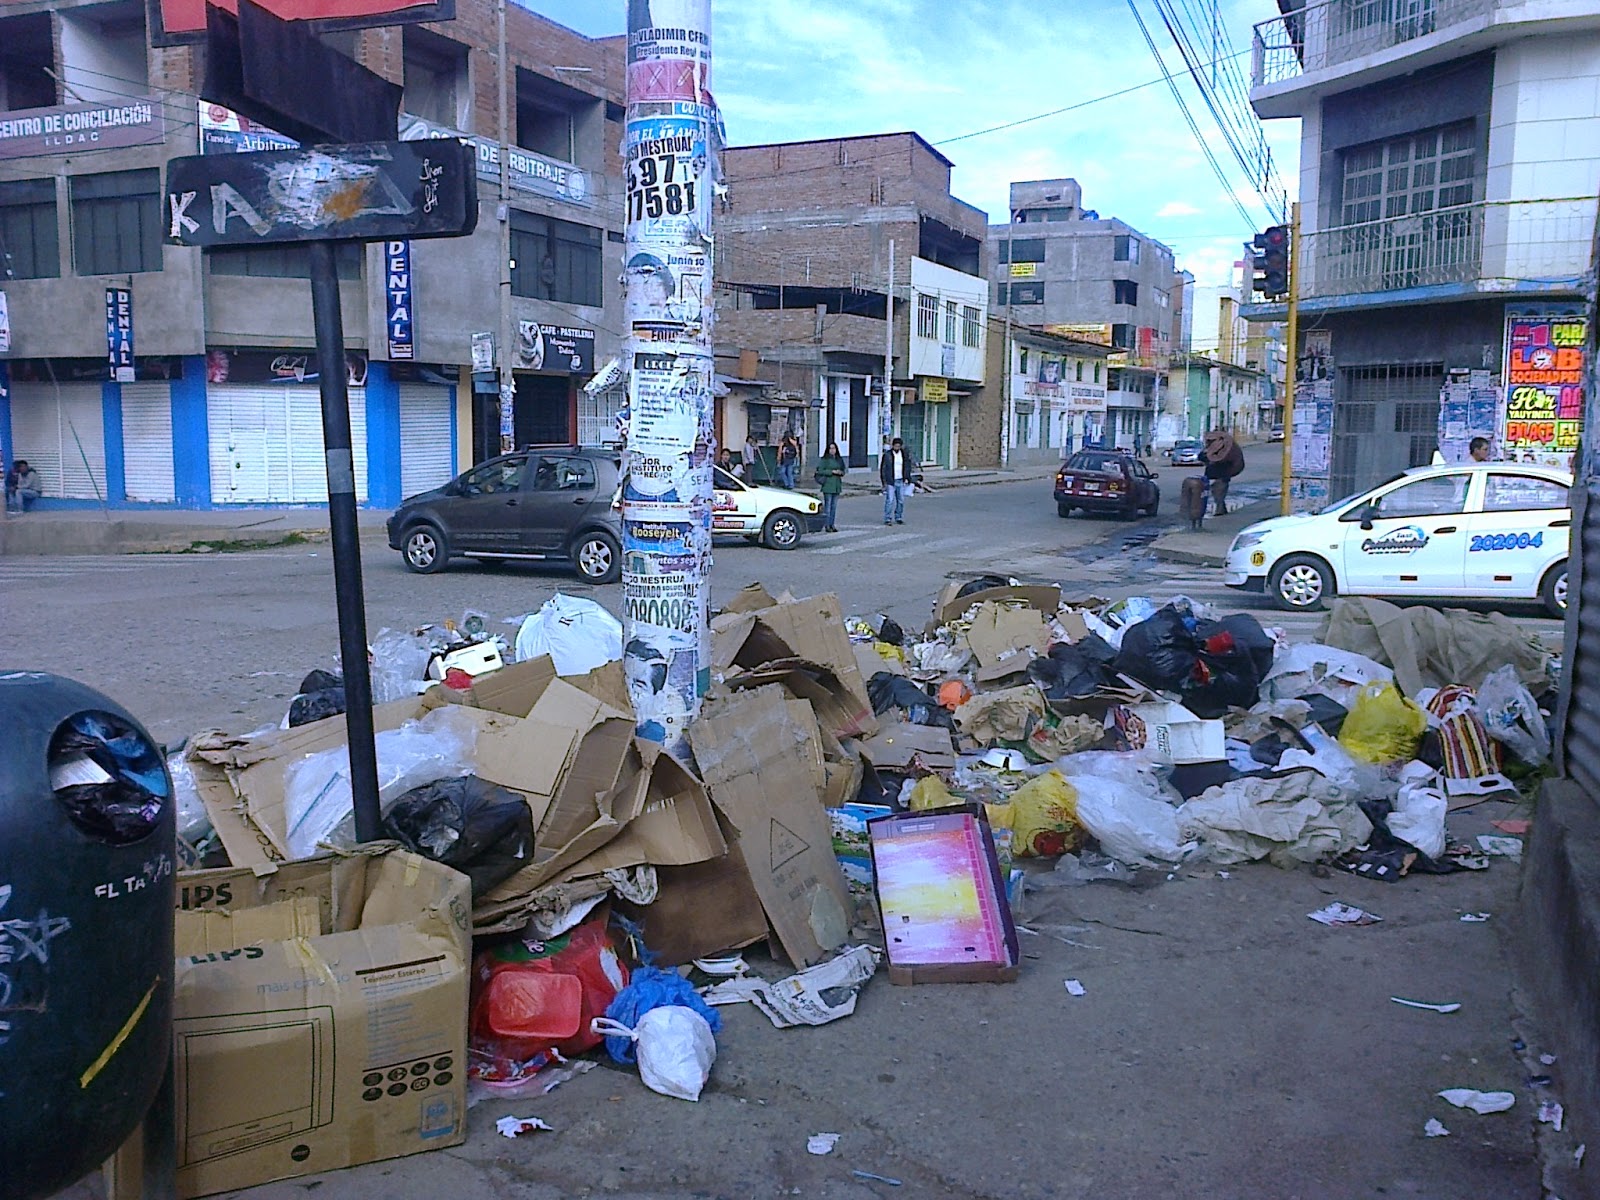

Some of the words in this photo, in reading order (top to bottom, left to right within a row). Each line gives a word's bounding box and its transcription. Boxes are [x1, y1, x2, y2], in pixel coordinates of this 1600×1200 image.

[638, 28, 686, 42] VLADIMIR
[637, 46, 679, 57] Presidente
[0, 118, 41, 138] CENTRO
[44, 115, 61, 132] DE
[64, 102, 152, 131] CONCILIACIÓN
[640, 136, 692, 158] MESTRUAL
[480, 143, 499, 163] DE
[509, 153, 566, 184] RBITRAJE
[387, 241, 409, 339] DENTAL
[106, 291, 115, 378] DENTAL
[117, 291, 130, 365] DENTAL
[1507, 422, 1555, 443] ENLACE
[632, 526, 680, 538] Roosevelt
[1469, 531, 1543, 552] 202004
[177, 882, 234, 911] IPS
